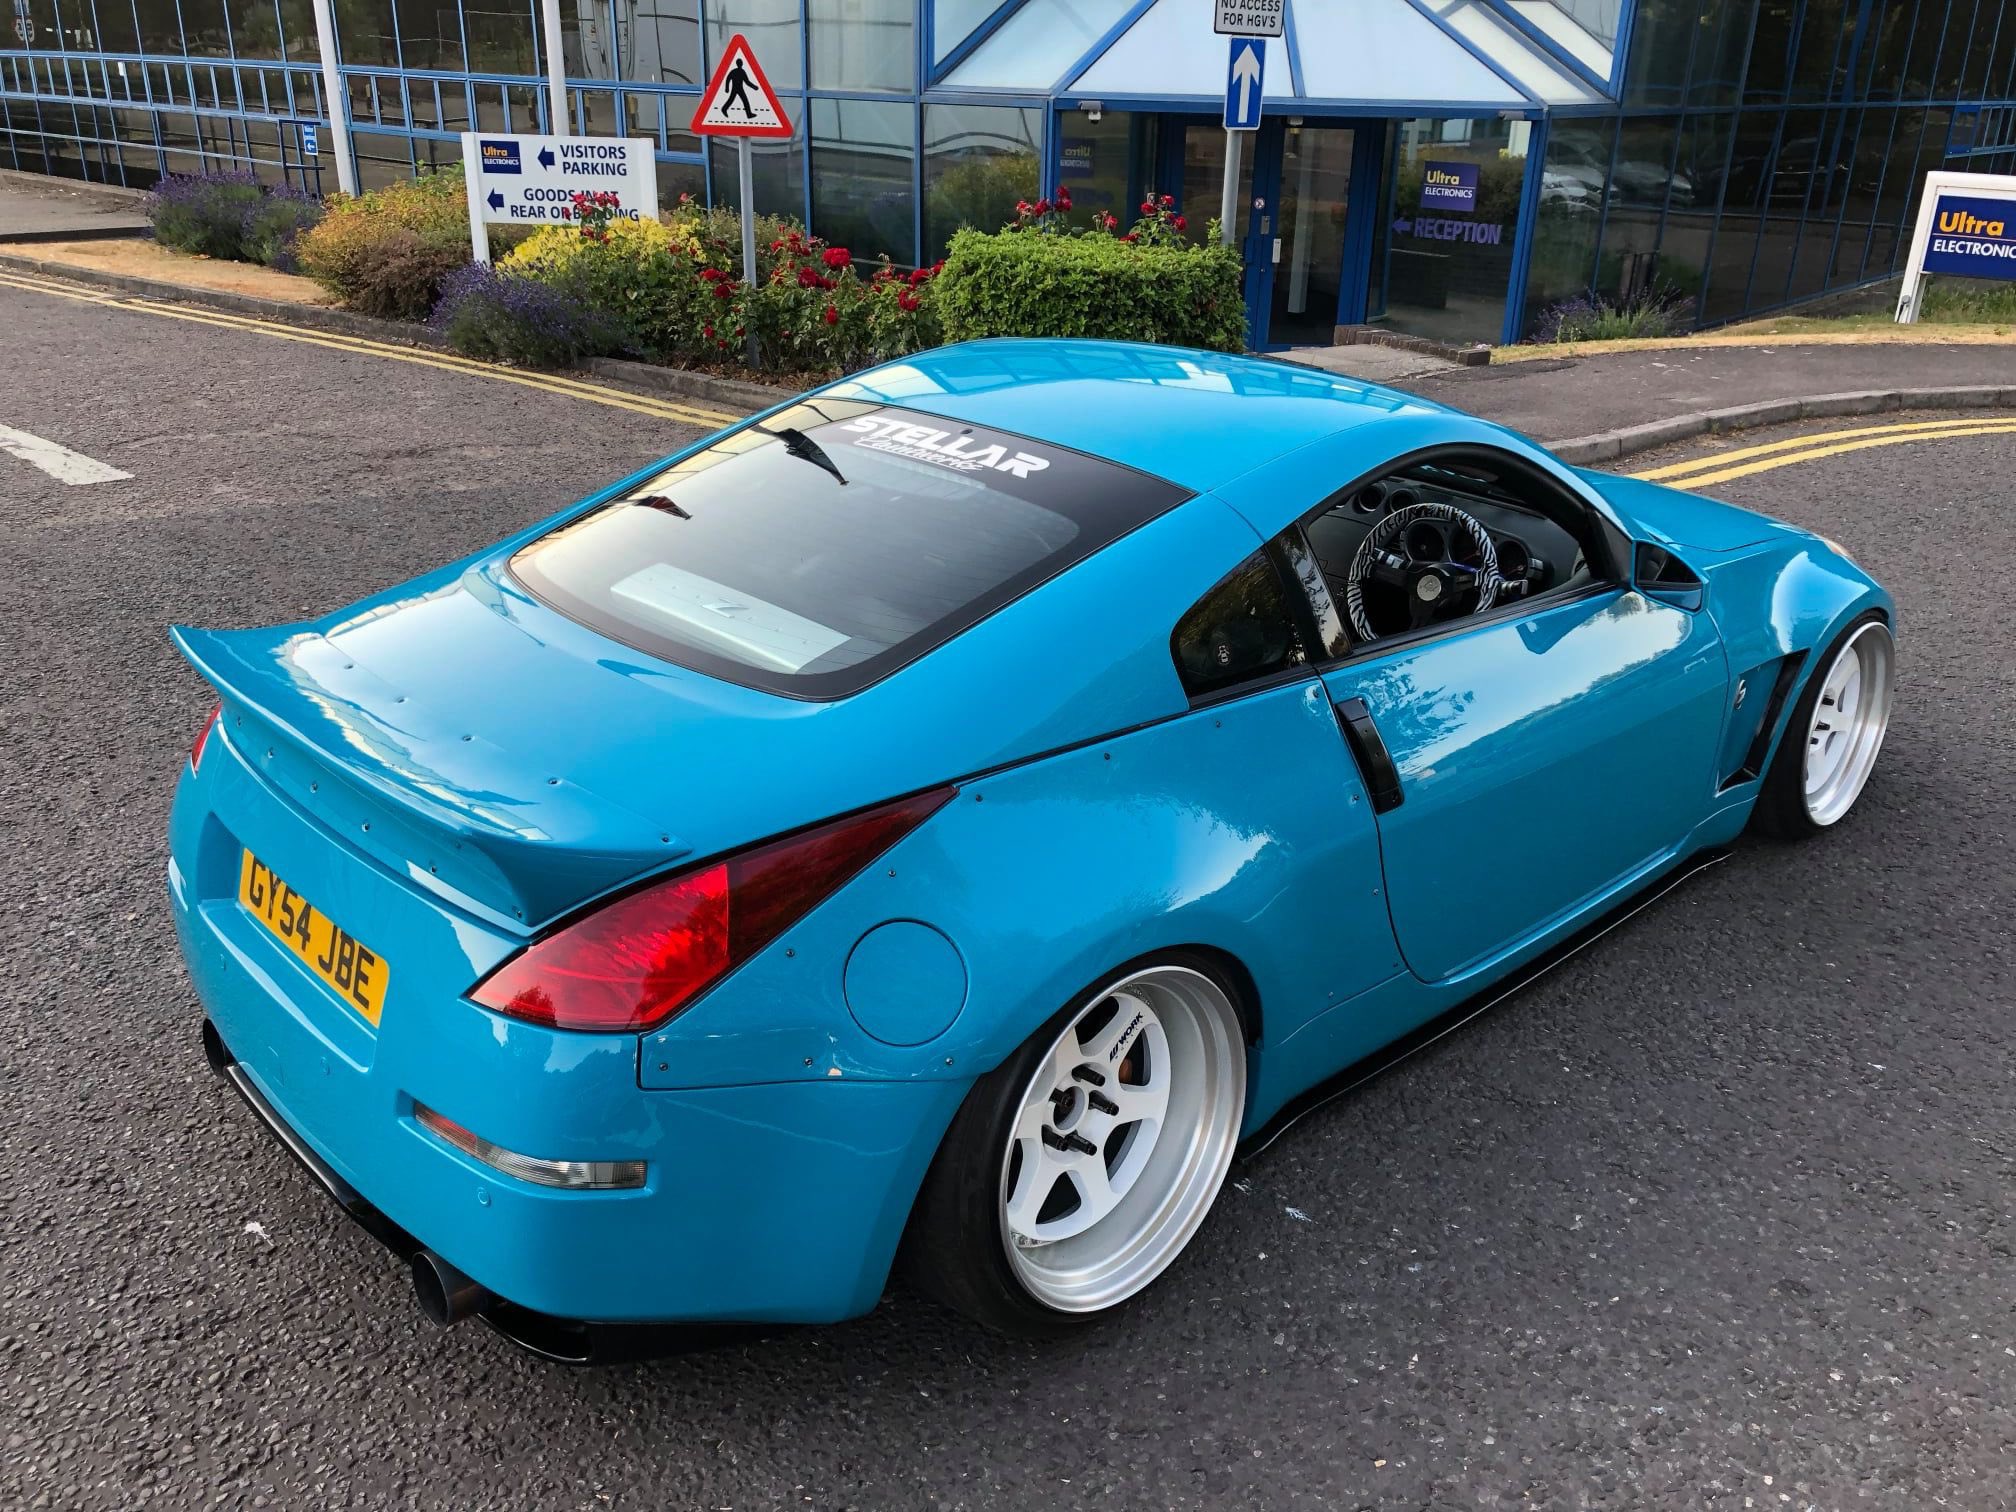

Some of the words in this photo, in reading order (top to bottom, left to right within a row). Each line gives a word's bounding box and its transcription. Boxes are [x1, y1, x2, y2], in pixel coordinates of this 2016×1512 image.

[1240, 0, 1280, 12] ACCESS
[1223, 13, 1243, 26] FOR
[1247, 14, 1276, 28] HGV'S
[483, 146, 508, 156] Ultra
[560, 144, 626, 160] VISITORS
[563, 161, 627, 176] PARKING
[1427, 170, 1460, 185] Ultra
[1425, 186, 1473, 199] ELECTRONICS
[511, 205, 546, 218] REAR
[1413, 218, 1502, 245] RECEPTION
[1940, 211, 2005, 237] Ultra
[840, 416, 1050, 479] STELLAR
[249, 855, 312, 953] GY54
[318, 924, 375, 1010] JBE
[1118, 1011, 1143, 1045] WORK
